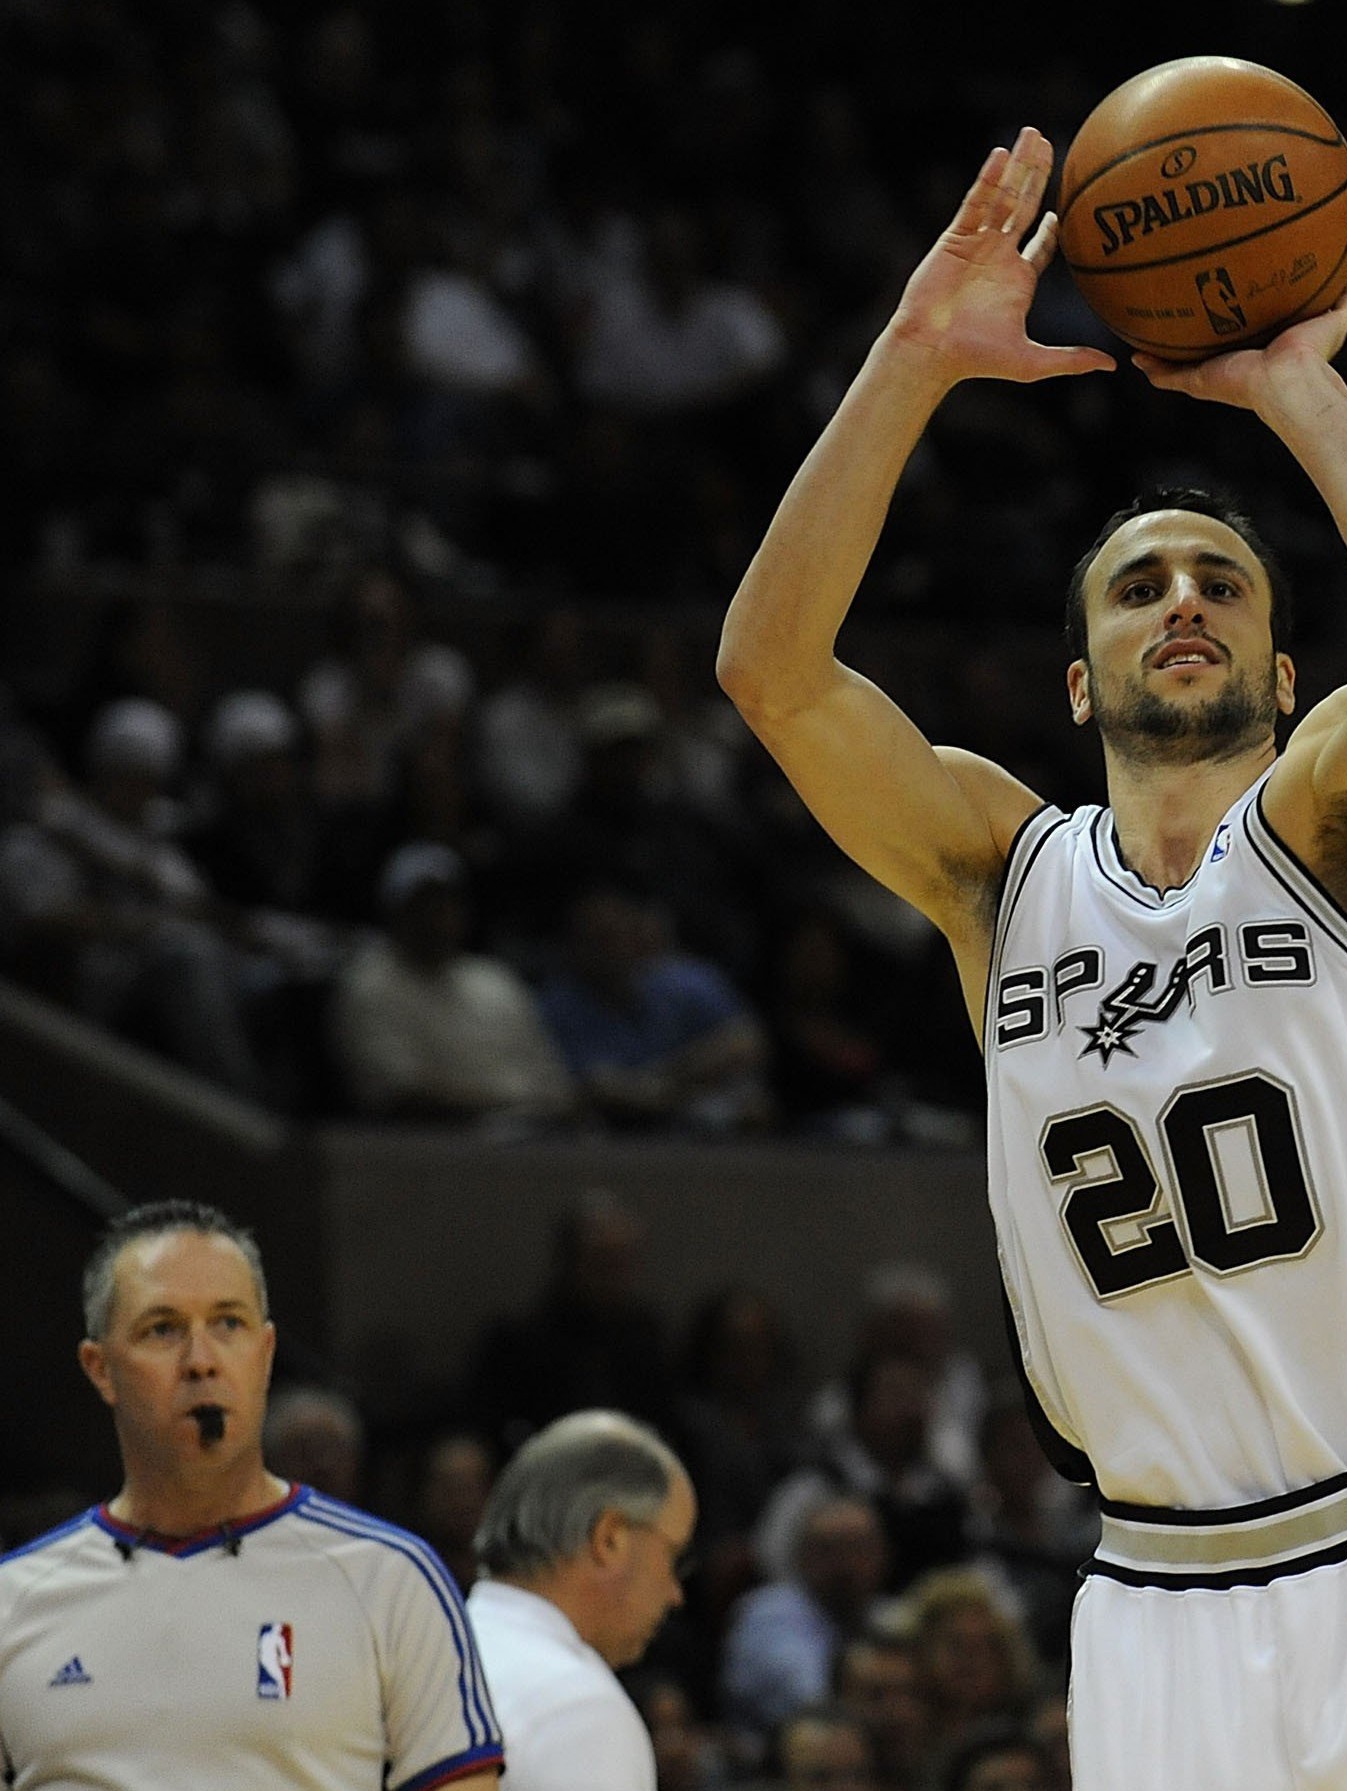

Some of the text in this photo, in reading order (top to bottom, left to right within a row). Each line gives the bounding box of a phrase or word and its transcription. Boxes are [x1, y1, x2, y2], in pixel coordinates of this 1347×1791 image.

[1094, 153, 1295, 255] SPALDING
[997, 919, 1318, 1070] SPURS
[1039, 1066, 1326, 1303] 20
